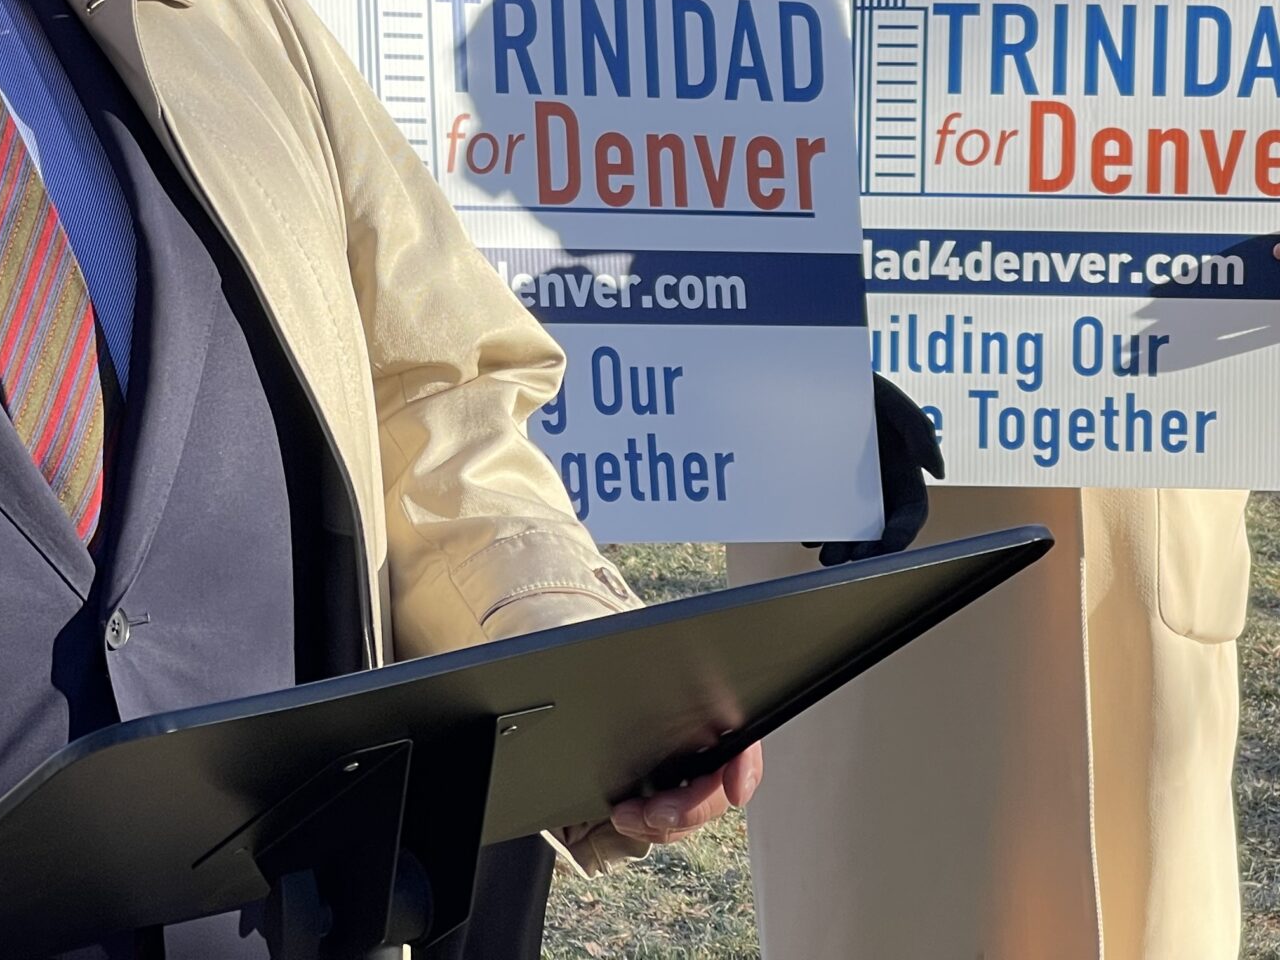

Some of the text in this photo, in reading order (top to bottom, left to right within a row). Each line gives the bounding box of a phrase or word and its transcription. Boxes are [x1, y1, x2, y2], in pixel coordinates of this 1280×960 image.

[446, 100, 826, 212] for Denver
[933, 112, 1020, 167] for
[591, 345, 684, 416] Our
[1072, 316, 1170, 376] Our
[968, 389, 1218, 468] Together
[561, 433, 735, 520] gether
